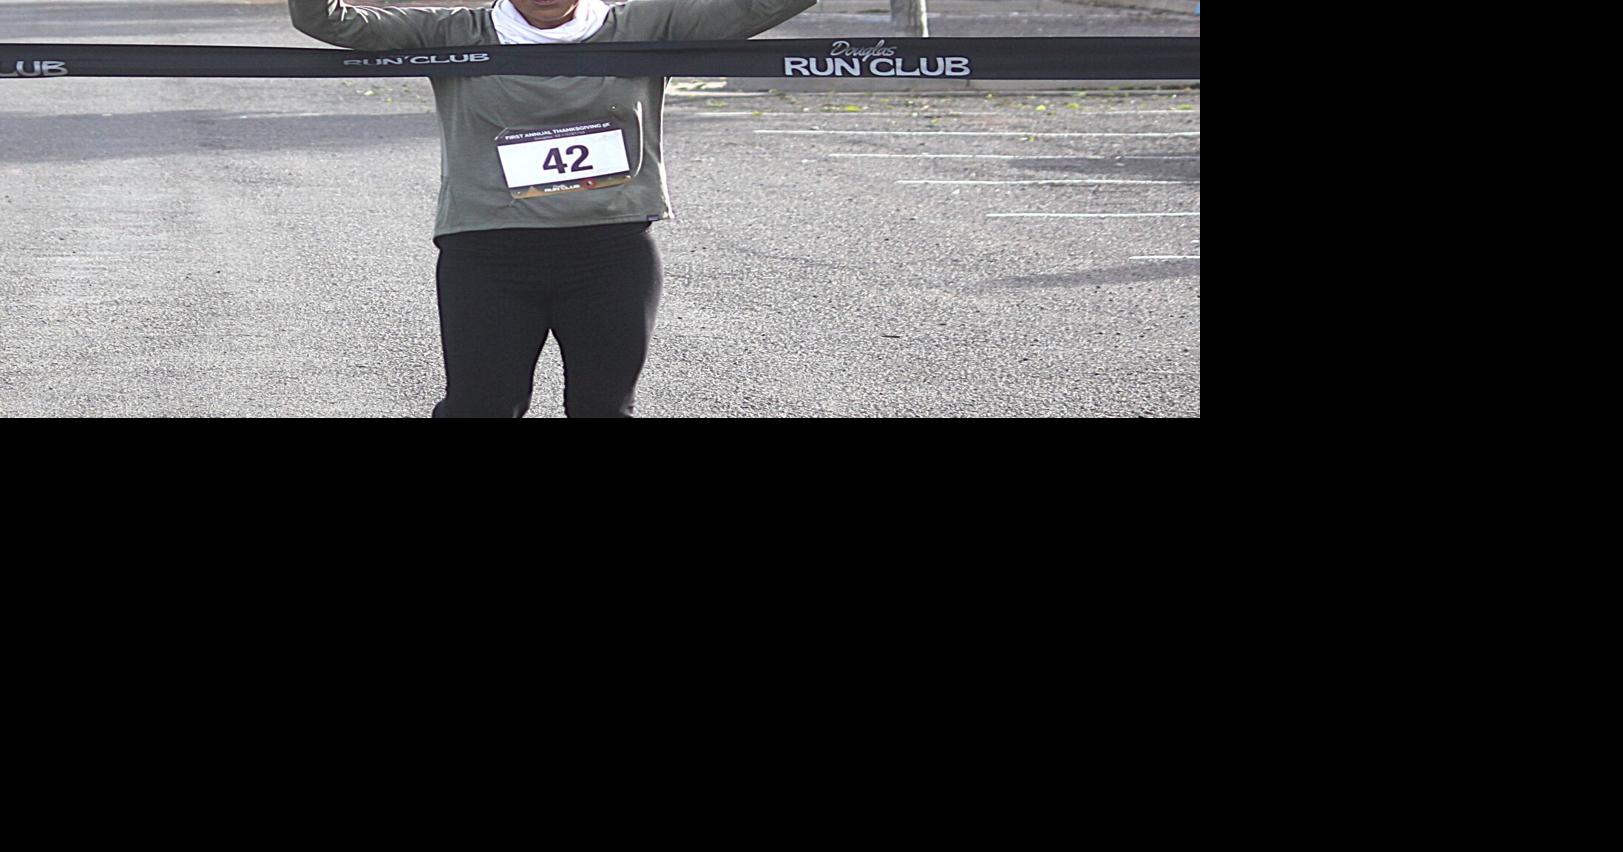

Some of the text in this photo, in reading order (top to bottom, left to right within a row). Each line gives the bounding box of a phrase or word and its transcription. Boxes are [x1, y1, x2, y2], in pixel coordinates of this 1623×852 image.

[830, 39, 897, 62] Douglas
[784, 57, 971, 76] RUN CLUB
[505, 133, 524, 141] FIRST
[524, 130, 552, 138] ANNUAL
[552, 124, 601, 134] THANKSGIVING
[542, 145, 594, 174] 42
